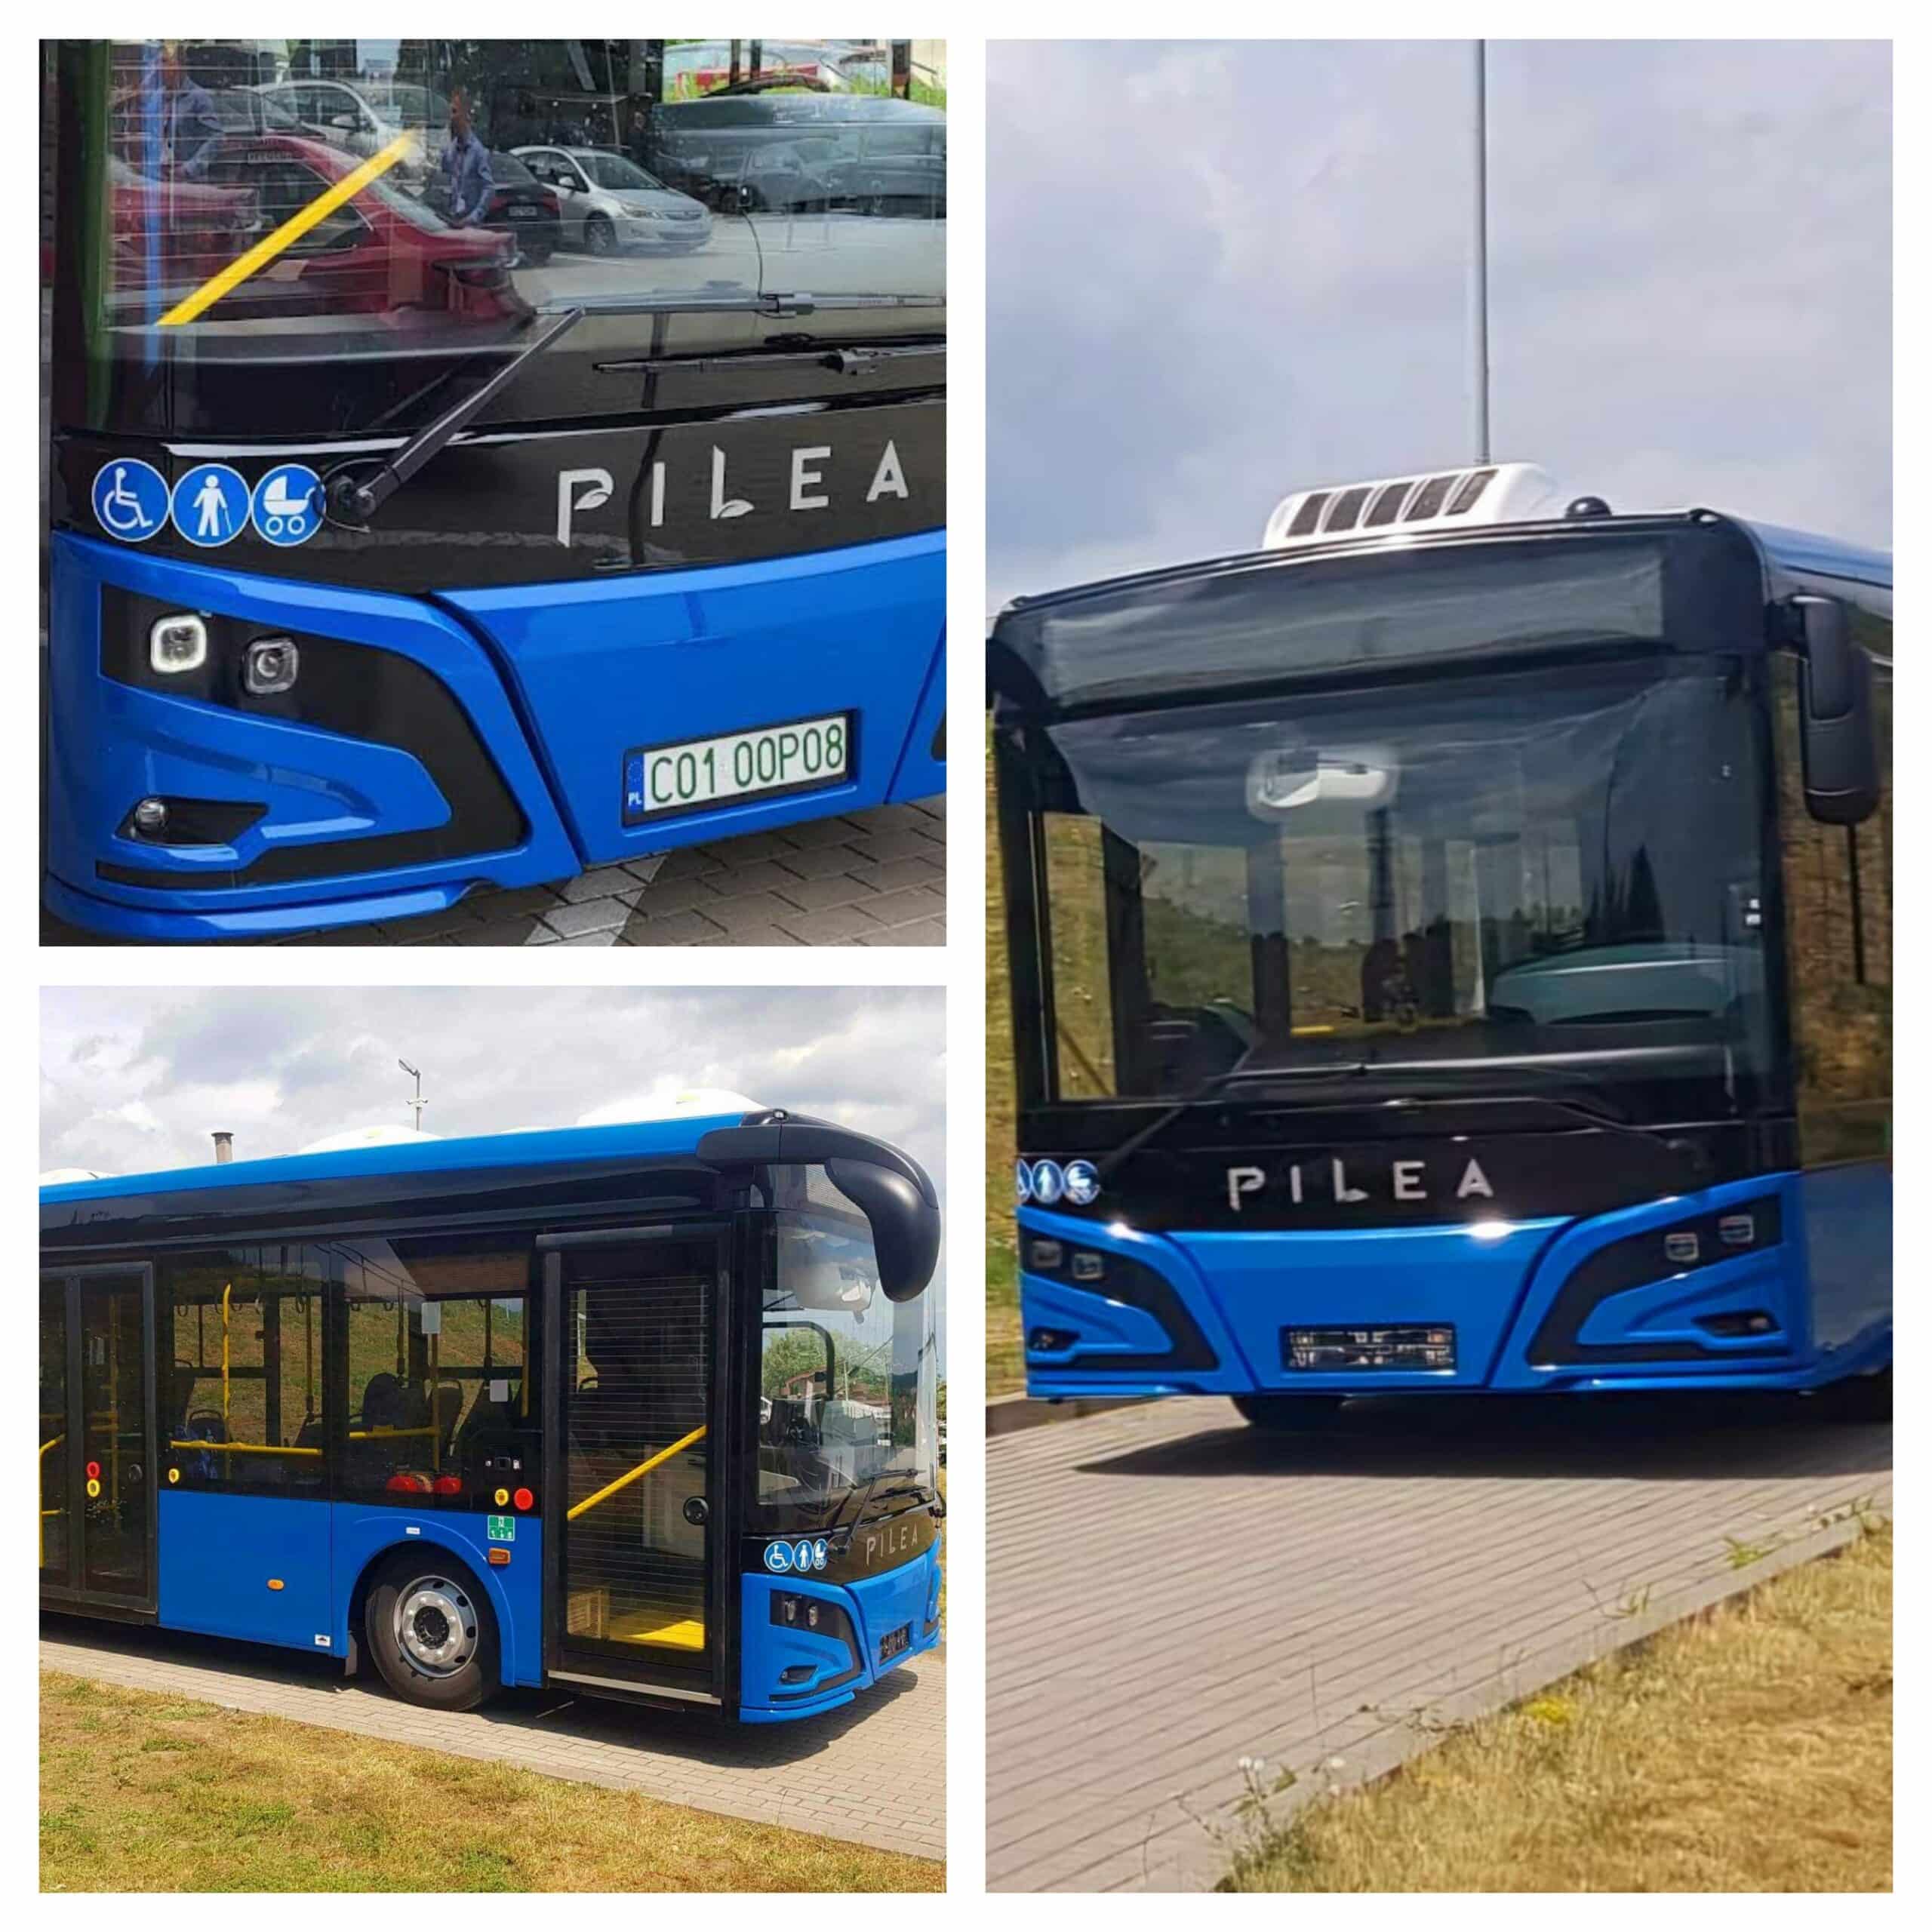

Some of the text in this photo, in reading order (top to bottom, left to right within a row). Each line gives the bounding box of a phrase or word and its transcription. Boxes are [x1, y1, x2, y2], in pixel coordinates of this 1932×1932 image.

[557, 440, 909, 549] PILEA
[651, 723, 843, 803] C01 00P08
[628, 792, 642, 807] PL
[1227, 1158, 1494, 1211] PILEA
[866, 1521, 918, 1566] PILEA
